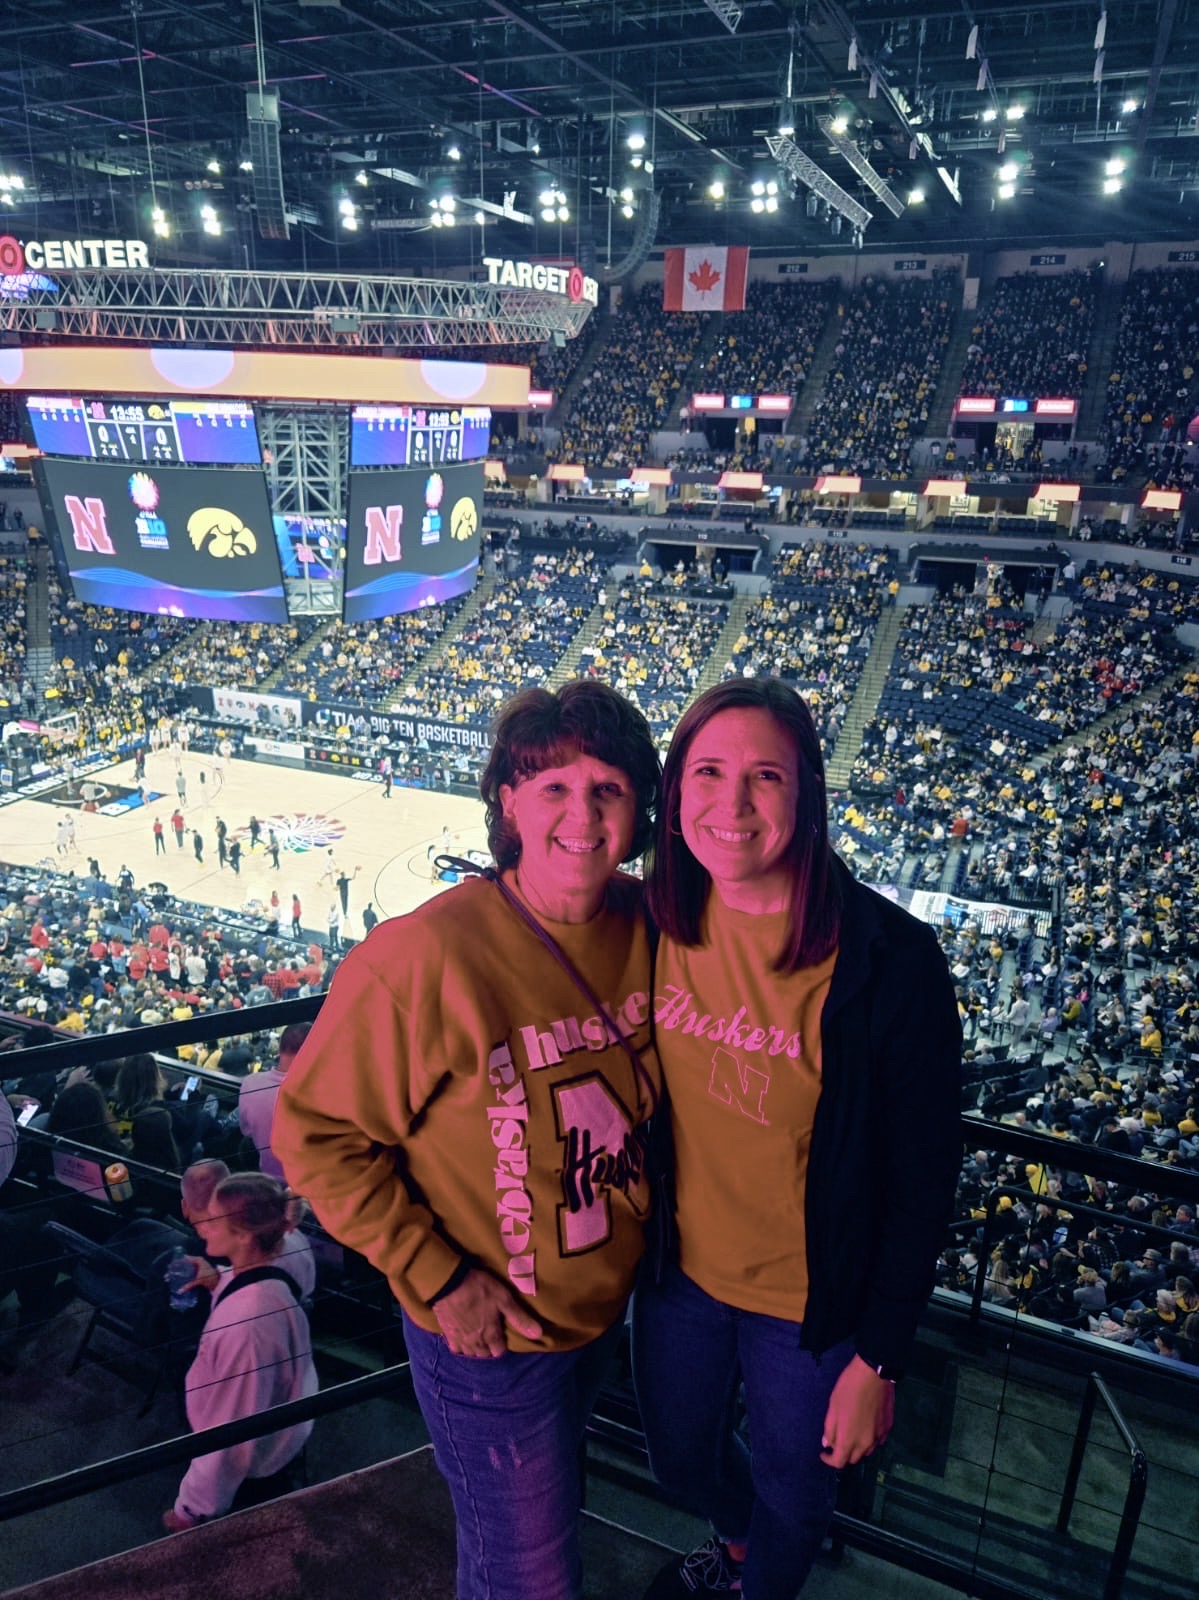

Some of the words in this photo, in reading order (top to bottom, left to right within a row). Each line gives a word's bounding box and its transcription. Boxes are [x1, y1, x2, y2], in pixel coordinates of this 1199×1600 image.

[25, 240, 149, 269] CENTER
[1040, 256, 1056, 264] 214
[1178, 252, 1196, 261] 215
[483, 257, 569, 294] TARGET
[97, 425, 110, 443] 0
[155, 427, 168, 446] 0
[64, 494, 117, 555] N
[363, 504, 404, 566] N
[370, 716, 391, 734] BIG
[393, 719, 414, 738] TEN
[417, 723, 492, 749] BASKETBALL
[518, 991, 650, 1070] huske
[654, 984, 801, 1058] Huskers
[708, 1046, 770, 1125] N
[486, 1041, 536, 1297] nebraska
